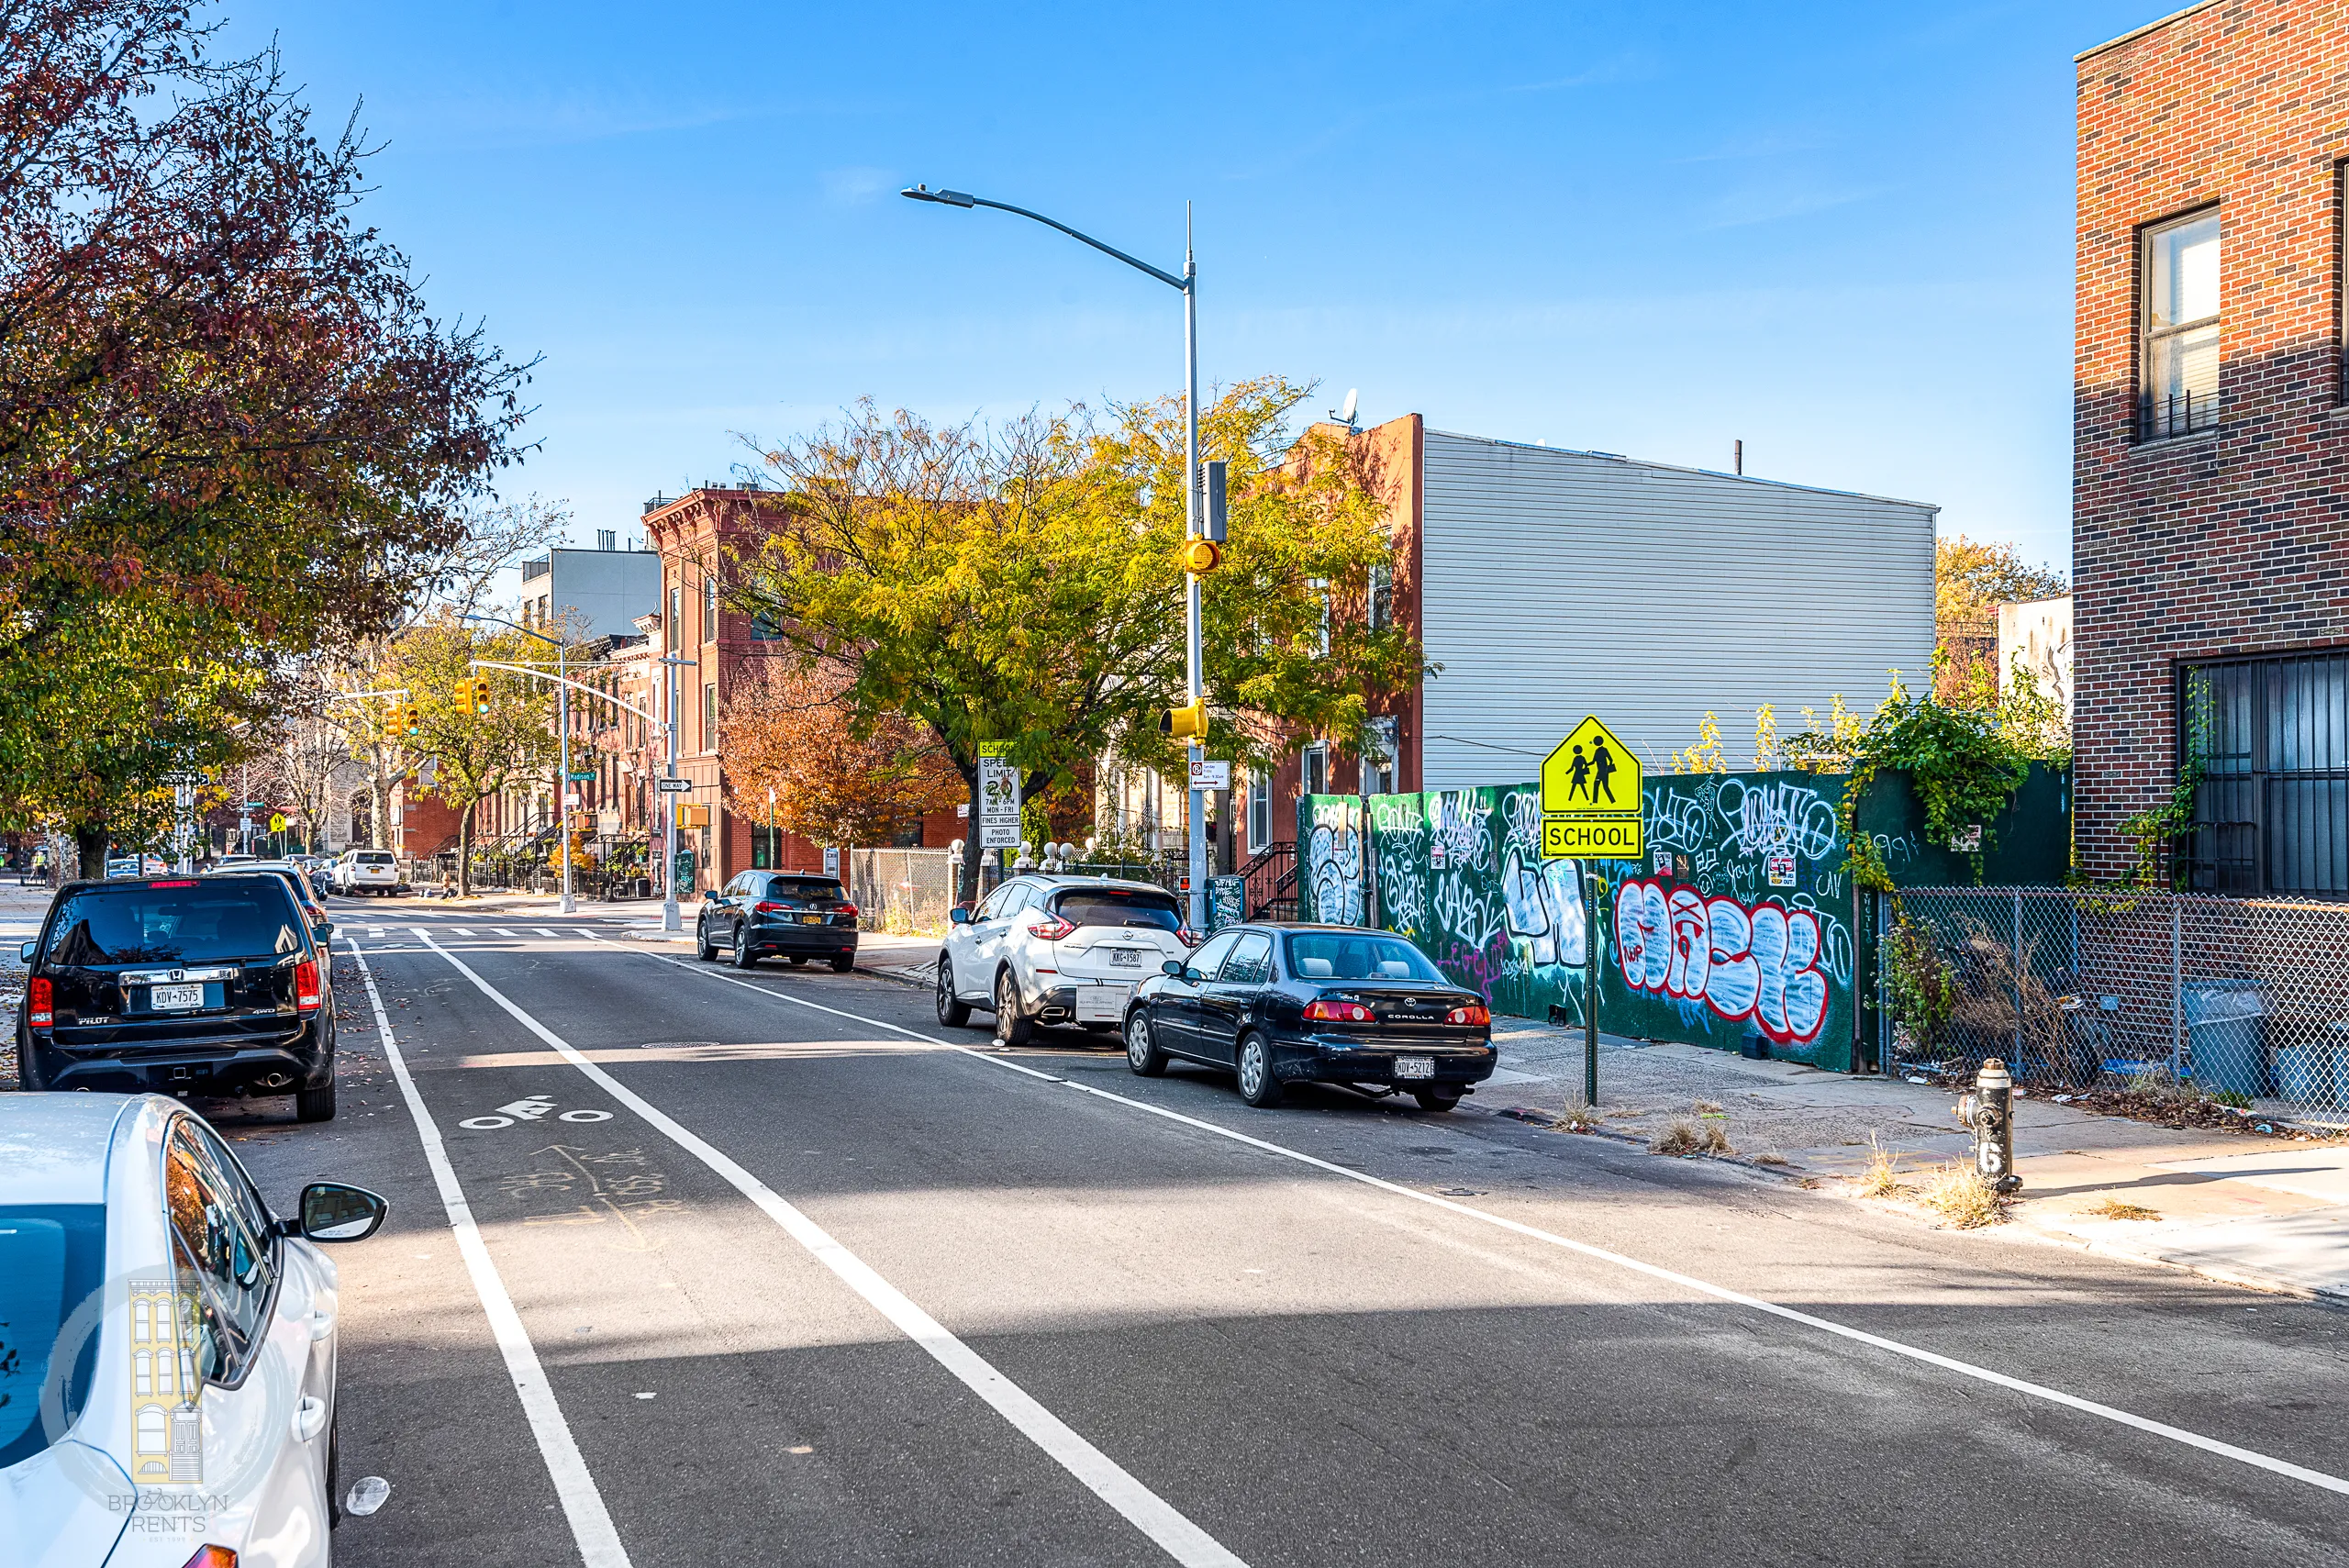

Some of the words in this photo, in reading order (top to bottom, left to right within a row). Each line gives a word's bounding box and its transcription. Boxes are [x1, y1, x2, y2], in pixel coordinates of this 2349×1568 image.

[987, 769, 1011, 778] LIMIT
[1549, 828, 1635, 846] SCHOOL
[78, 1017, 110, 1025] PILOT
[1979, 1141, 2002, 1173] 6
